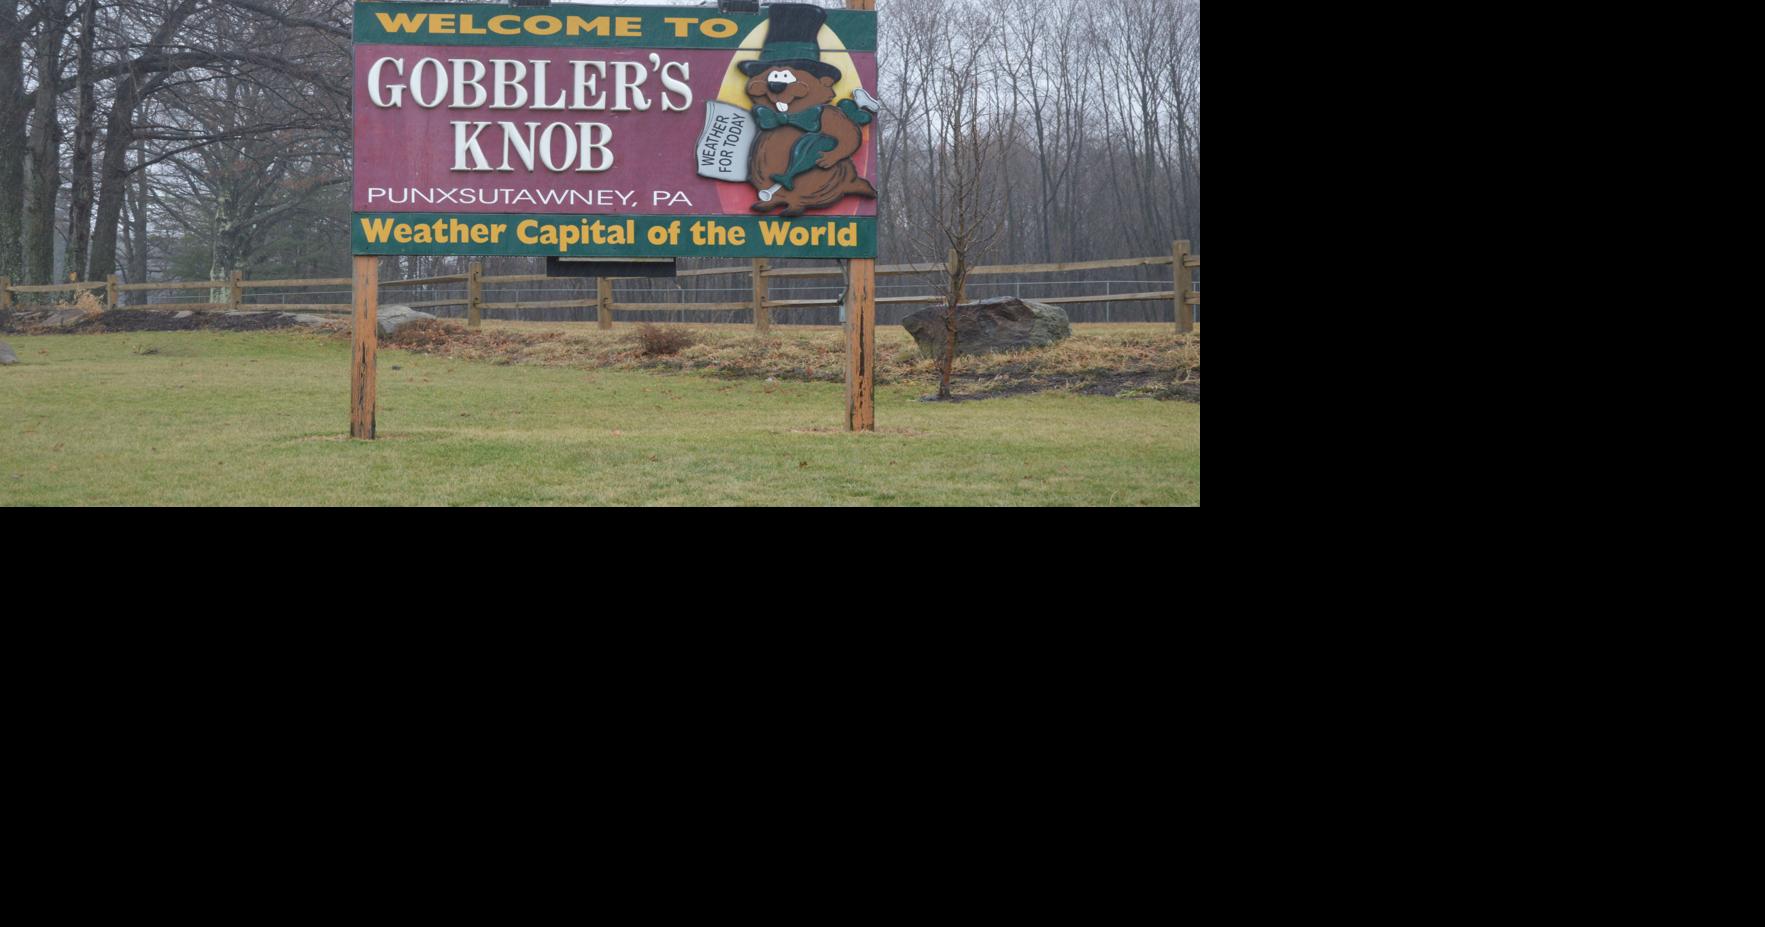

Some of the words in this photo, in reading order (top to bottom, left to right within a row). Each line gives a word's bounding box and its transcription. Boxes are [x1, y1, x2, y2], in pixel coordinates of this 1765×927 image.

[375, 12, 642, 37] WELCOME
[664, 17, 738, 38] TO
[367, 52, 693, 111] GOBBLER'S
[450, 121, 614, 173] KNOB
[701, 115, 729, 166] WEATHER
[723, 113, 746, 147] TODAY
[719, 150, 734, 173] FOR
[368, 187, 637, 207] PUNXSUTAWNEY,
[653, 190, 693, 207] PA
[360, 217, 507, 244] Weather
[516, 218, 635, 252] Capital
[647, 220, 681, 246] of
[690, 220, 746, 246] the
[758, 221, 857, 247] World
